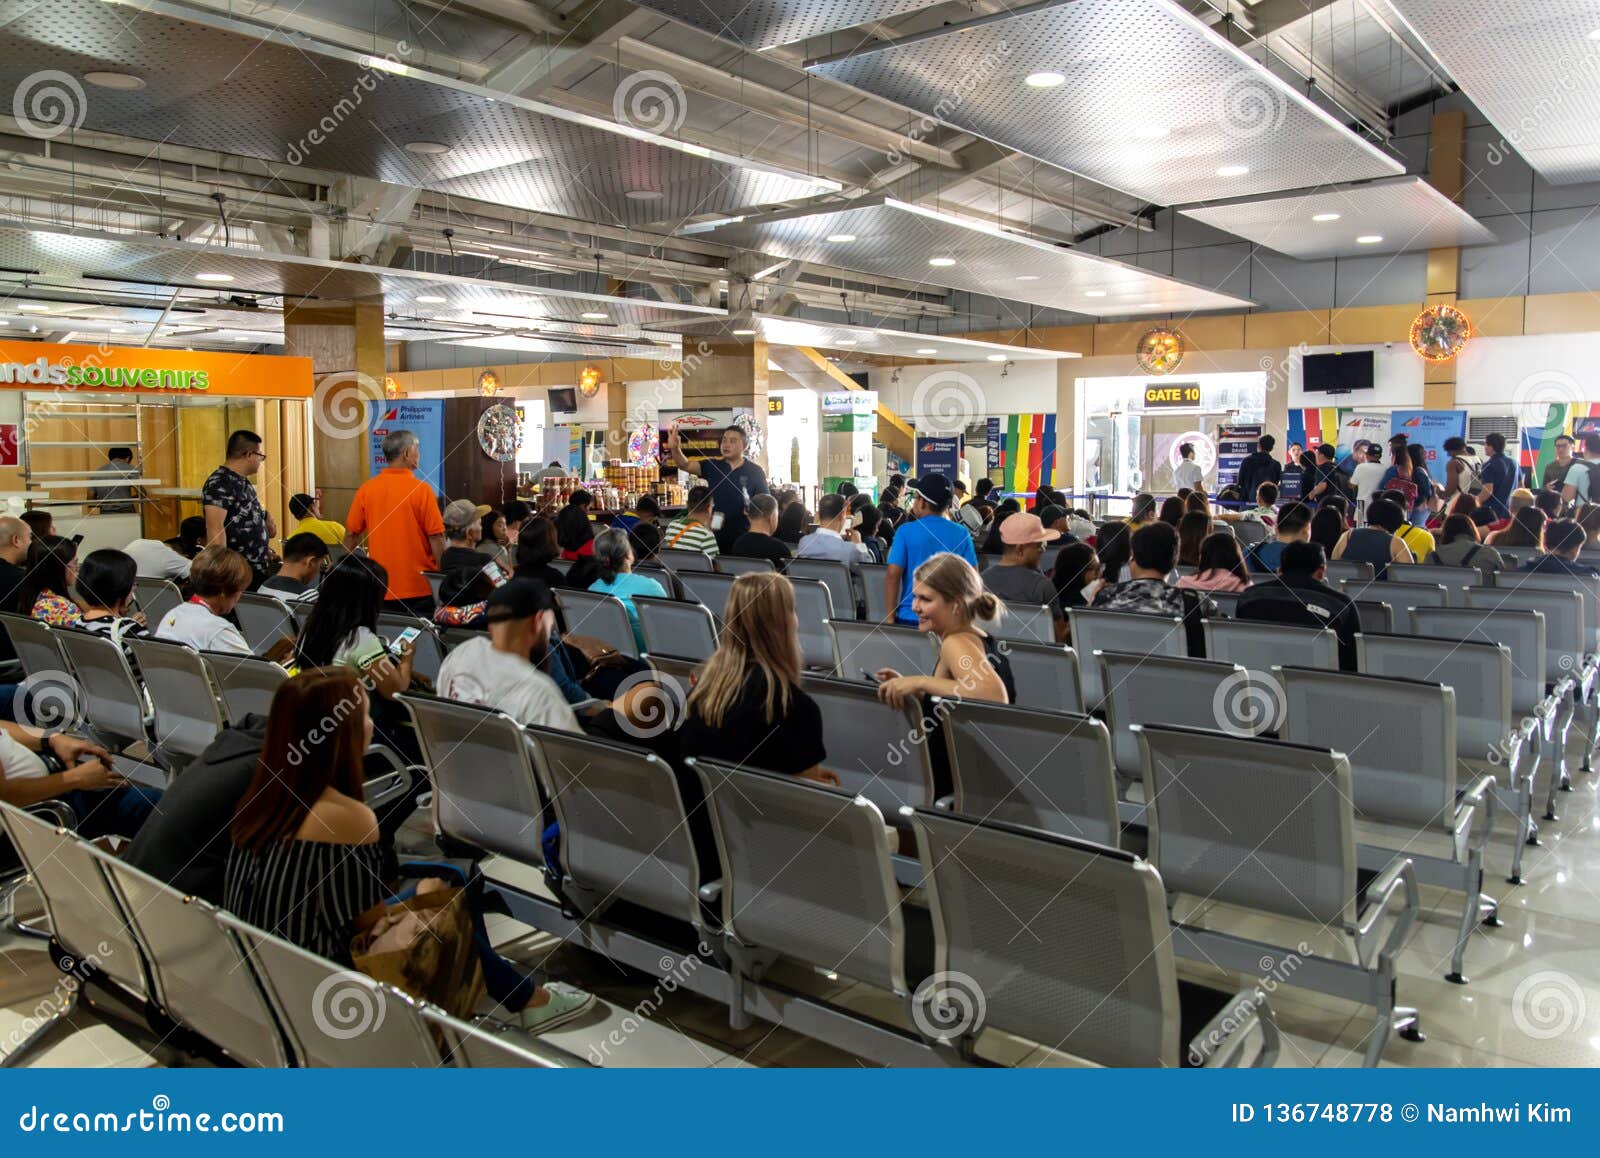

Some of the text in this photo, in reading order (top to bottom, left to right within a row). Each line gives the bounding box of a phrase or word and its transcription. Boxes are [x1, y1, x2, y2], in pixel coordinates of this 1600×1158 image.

[1146, 387, 1199, 402] GATE 10
[776, 401, 783, 411] 9
[400, 413, 425, 421] Airlines
